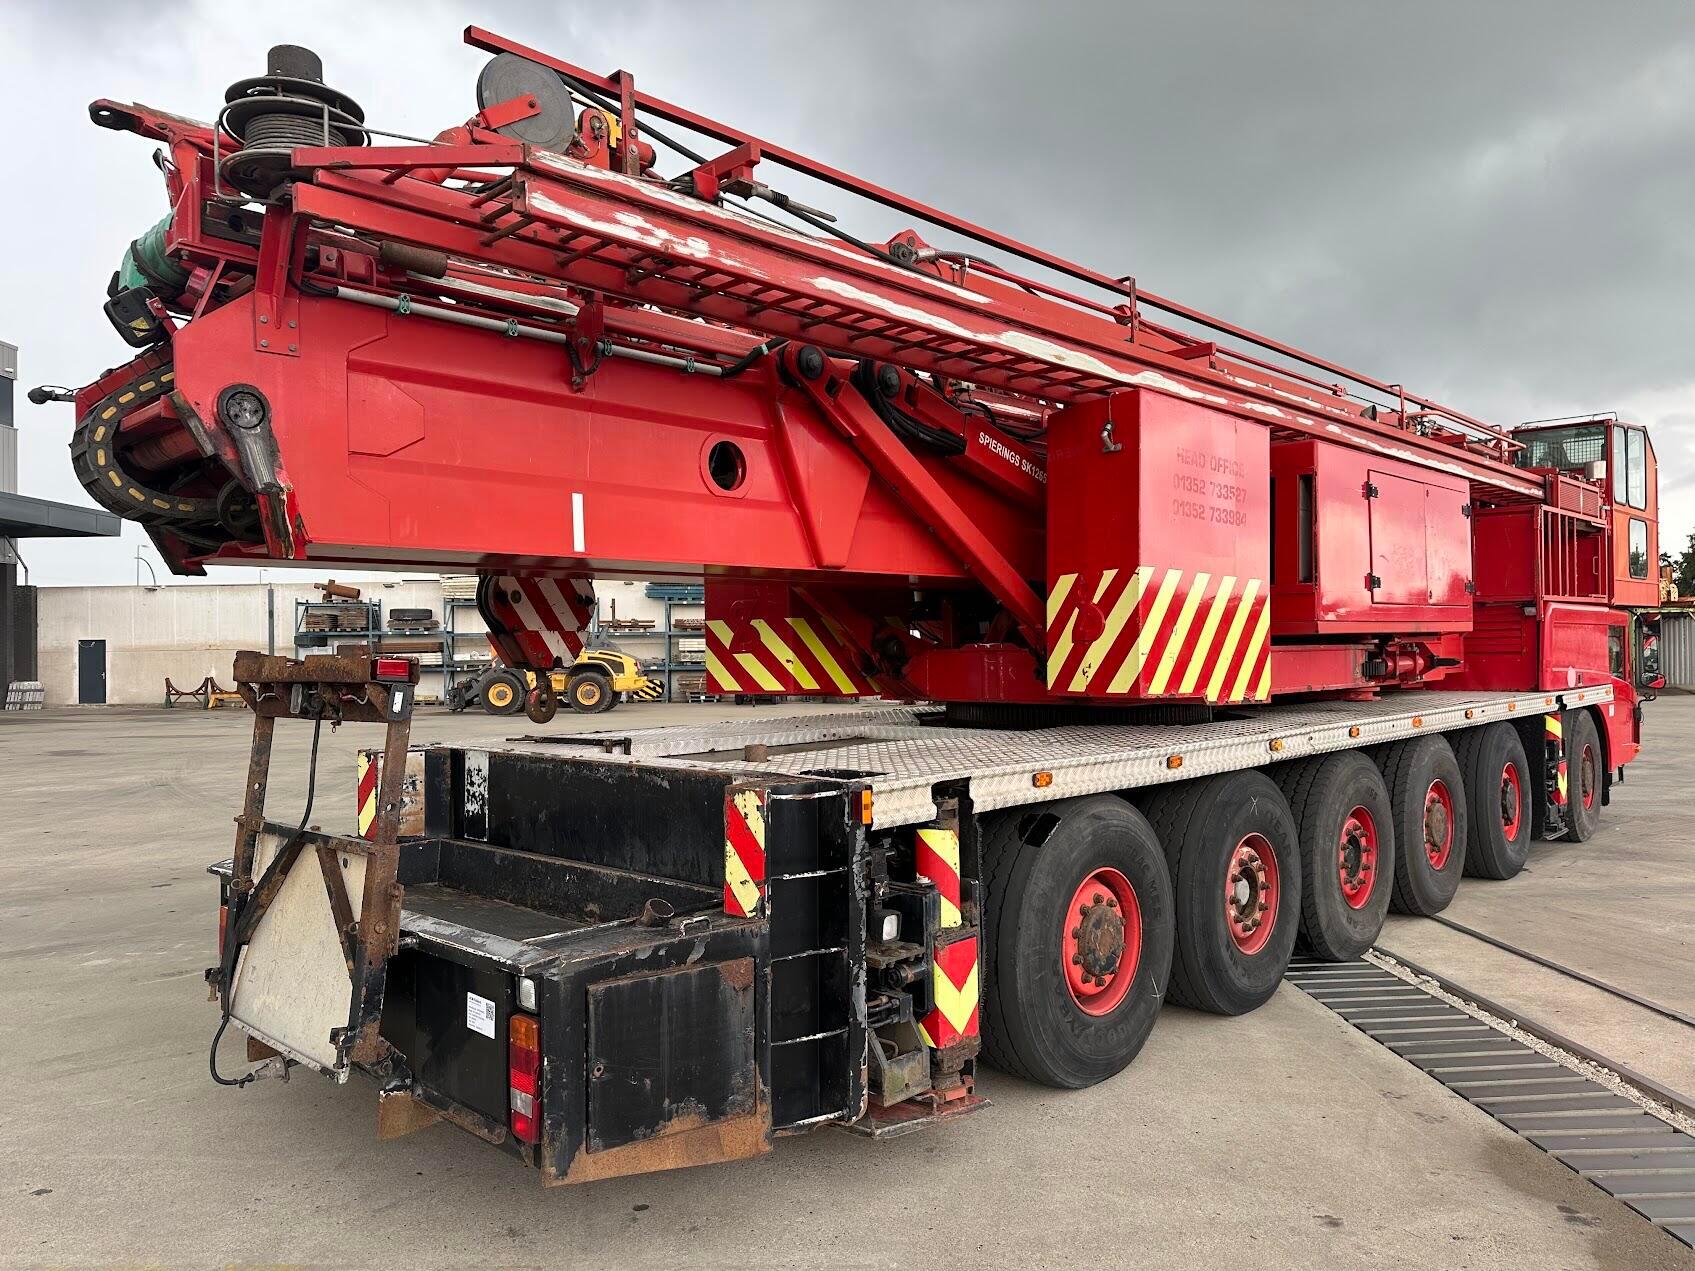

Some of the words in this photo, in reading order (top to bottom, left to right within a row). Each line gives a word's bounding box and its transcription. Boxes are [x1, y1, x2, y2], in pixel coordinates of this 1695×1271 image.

[978, 431, 1020, 467] SPIERINGS
[1176, 446, 1206, 469] HEAD
[1209, 455, 1246, 479] OFFICE
[1173, 473, 1206, 496] 01352
[1209, 481, 1248, 504] 733527
[1173, 498, 1206, 521] 01352
[1208, 506, 1247, 527] 733984
